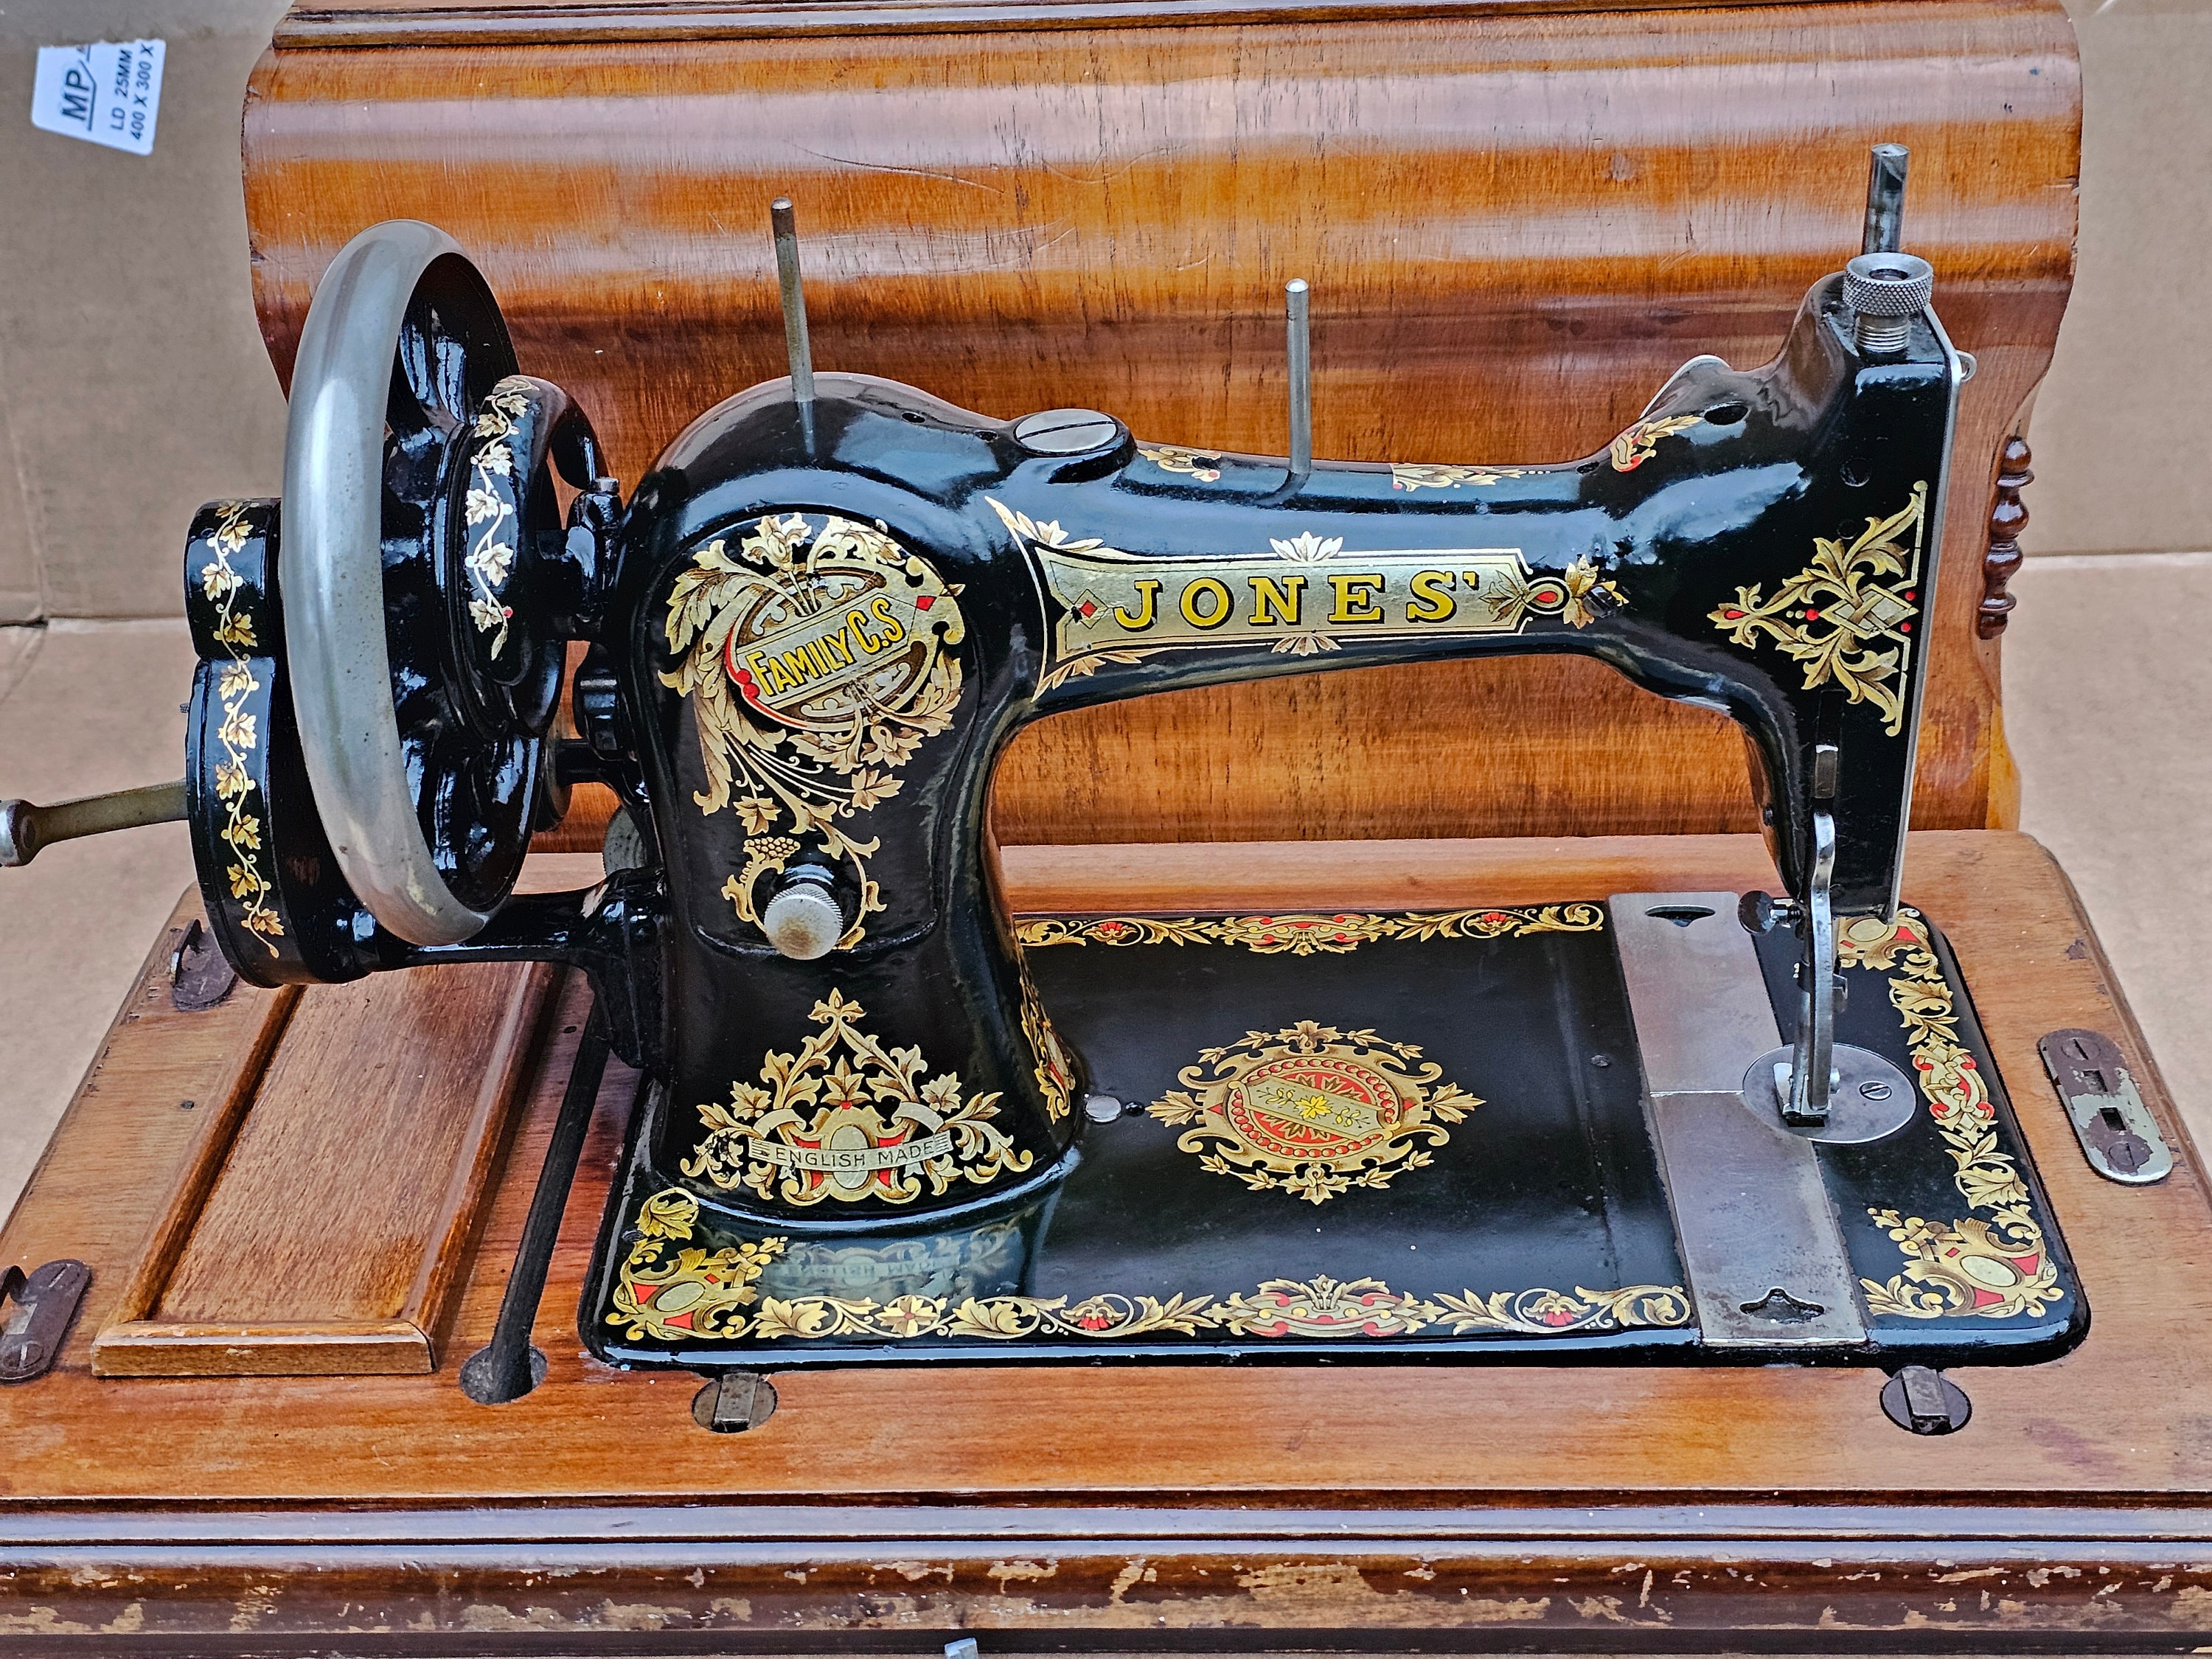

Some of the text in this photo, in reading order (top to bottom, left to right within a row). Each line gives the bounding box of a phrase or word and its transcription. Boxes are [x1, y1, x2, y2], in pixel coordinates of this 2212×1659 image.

[62, 69, 89, 121] MP
[111, 49, 133, 130] LD 25MM
[131, 44, 153, 139] 400 X 300 X
[746, 628, 857, 697] FAMILY
[775, 1141, 933, 1167] ENGLISH MADE
